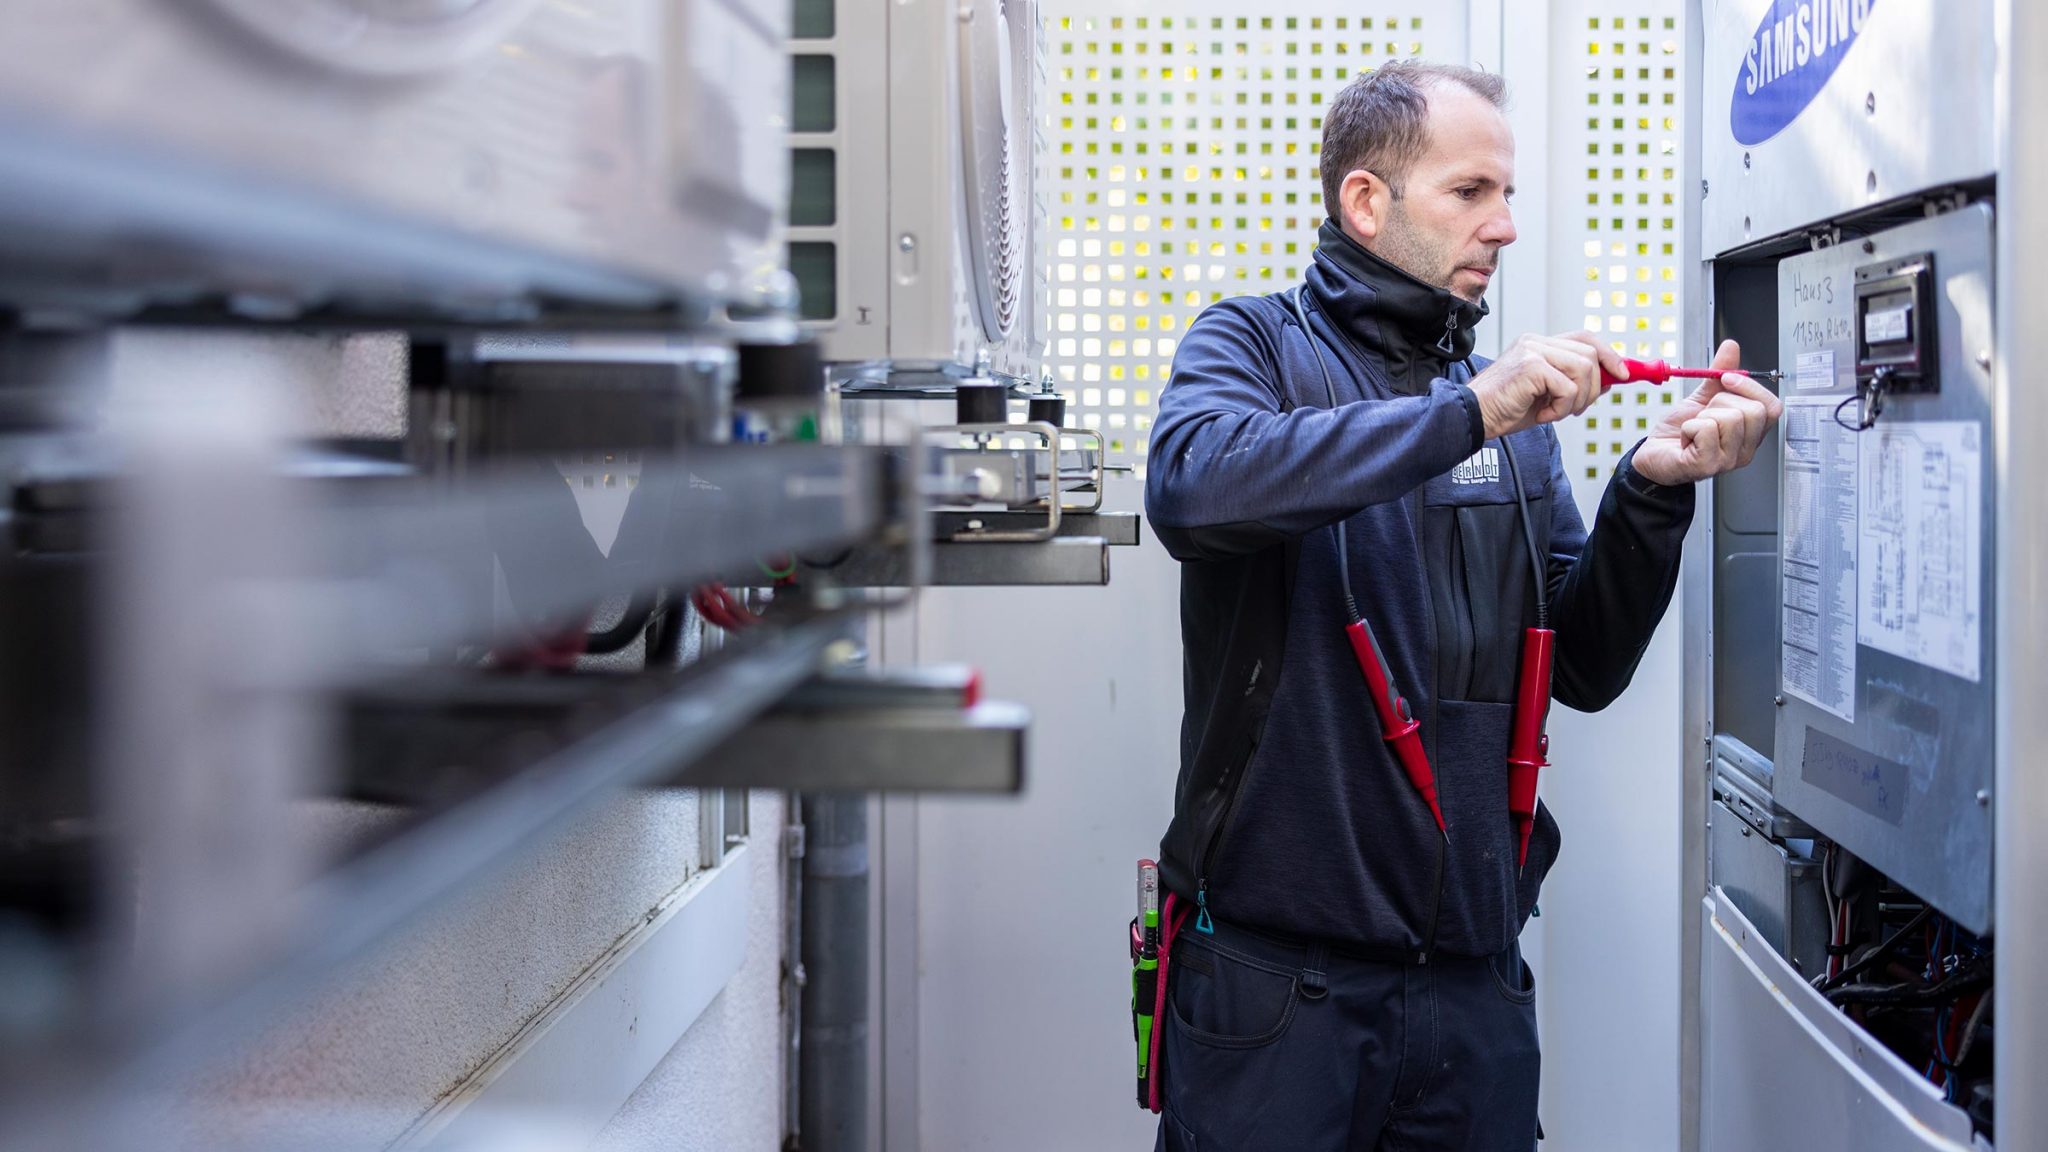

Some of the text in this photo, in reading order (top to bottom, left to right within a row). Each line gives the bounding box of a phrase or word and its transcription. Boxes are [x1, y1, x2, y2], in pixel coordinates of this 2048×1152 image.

[1793, 271, 1833, 308] Haus 3
[1453, 464, 1499, 477] BERNDT
